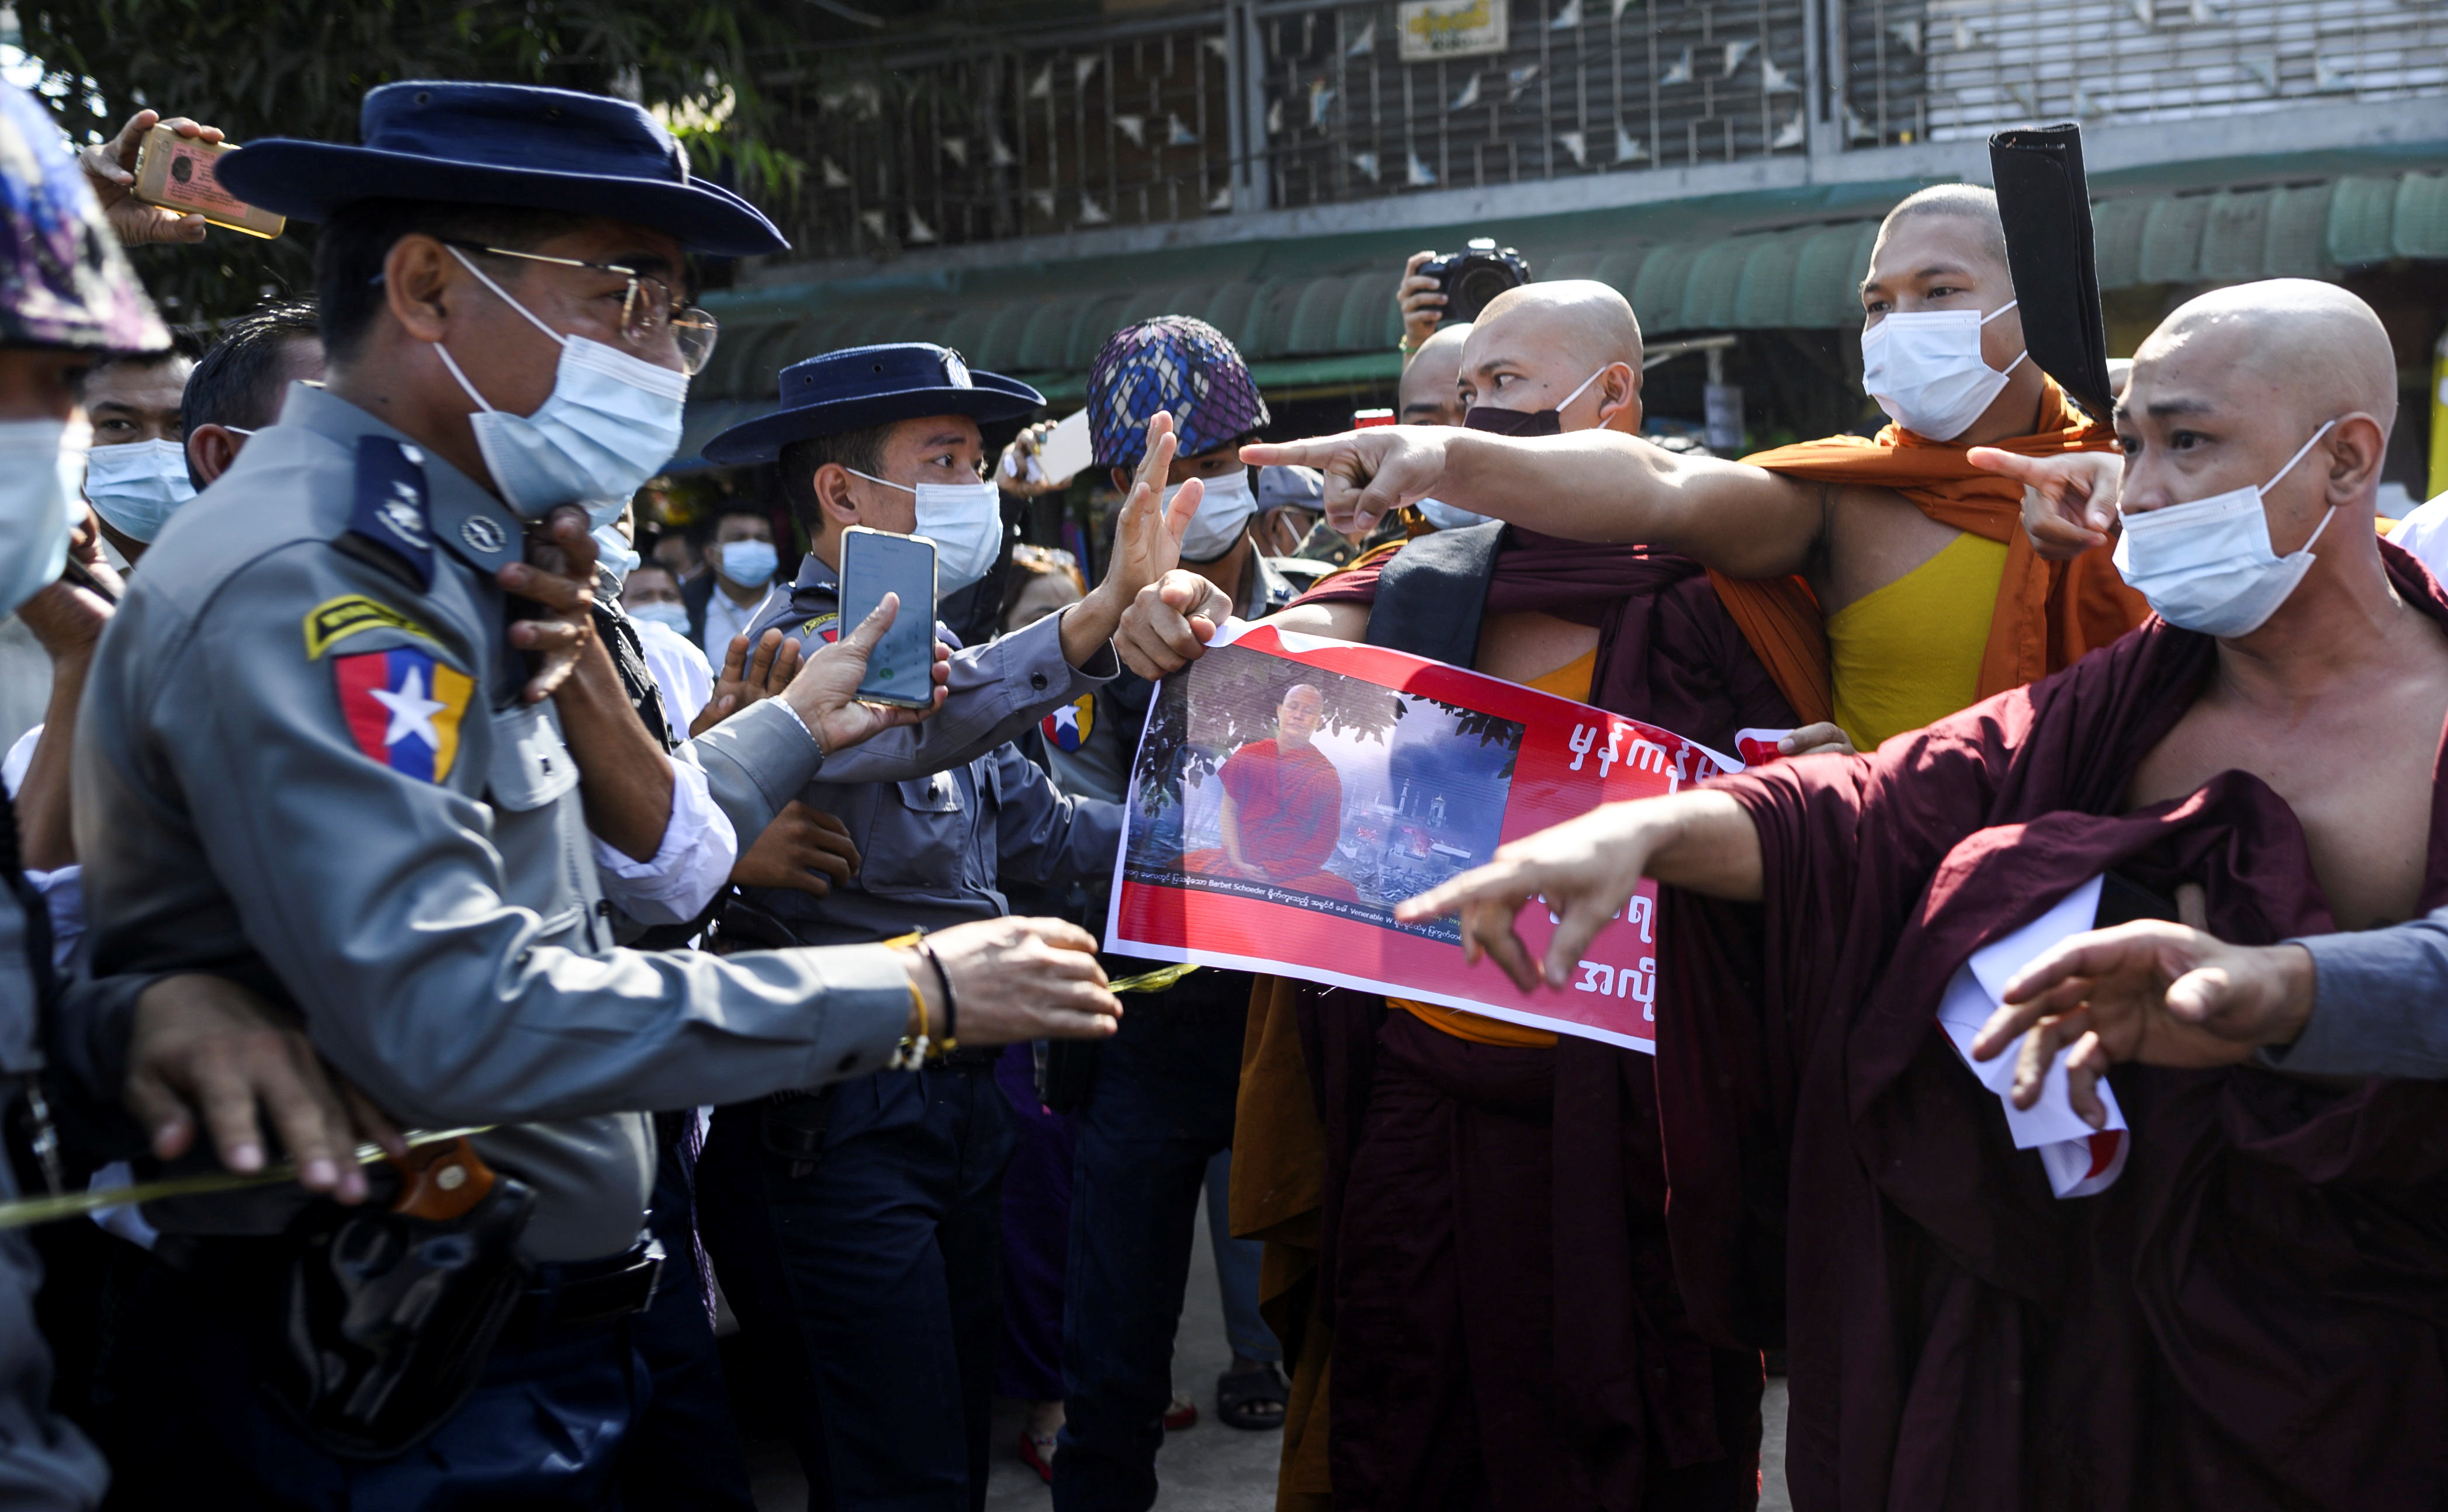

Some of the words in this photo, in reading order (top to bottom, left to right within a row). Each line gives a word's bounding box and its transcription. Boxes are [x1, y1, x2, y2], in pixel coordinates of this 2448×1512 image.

[1209, 879, 1232, 890] Barbet
[1234, 883, 1266, 896] Schoeder
[1350, 907, 1384, 922] Venerable
